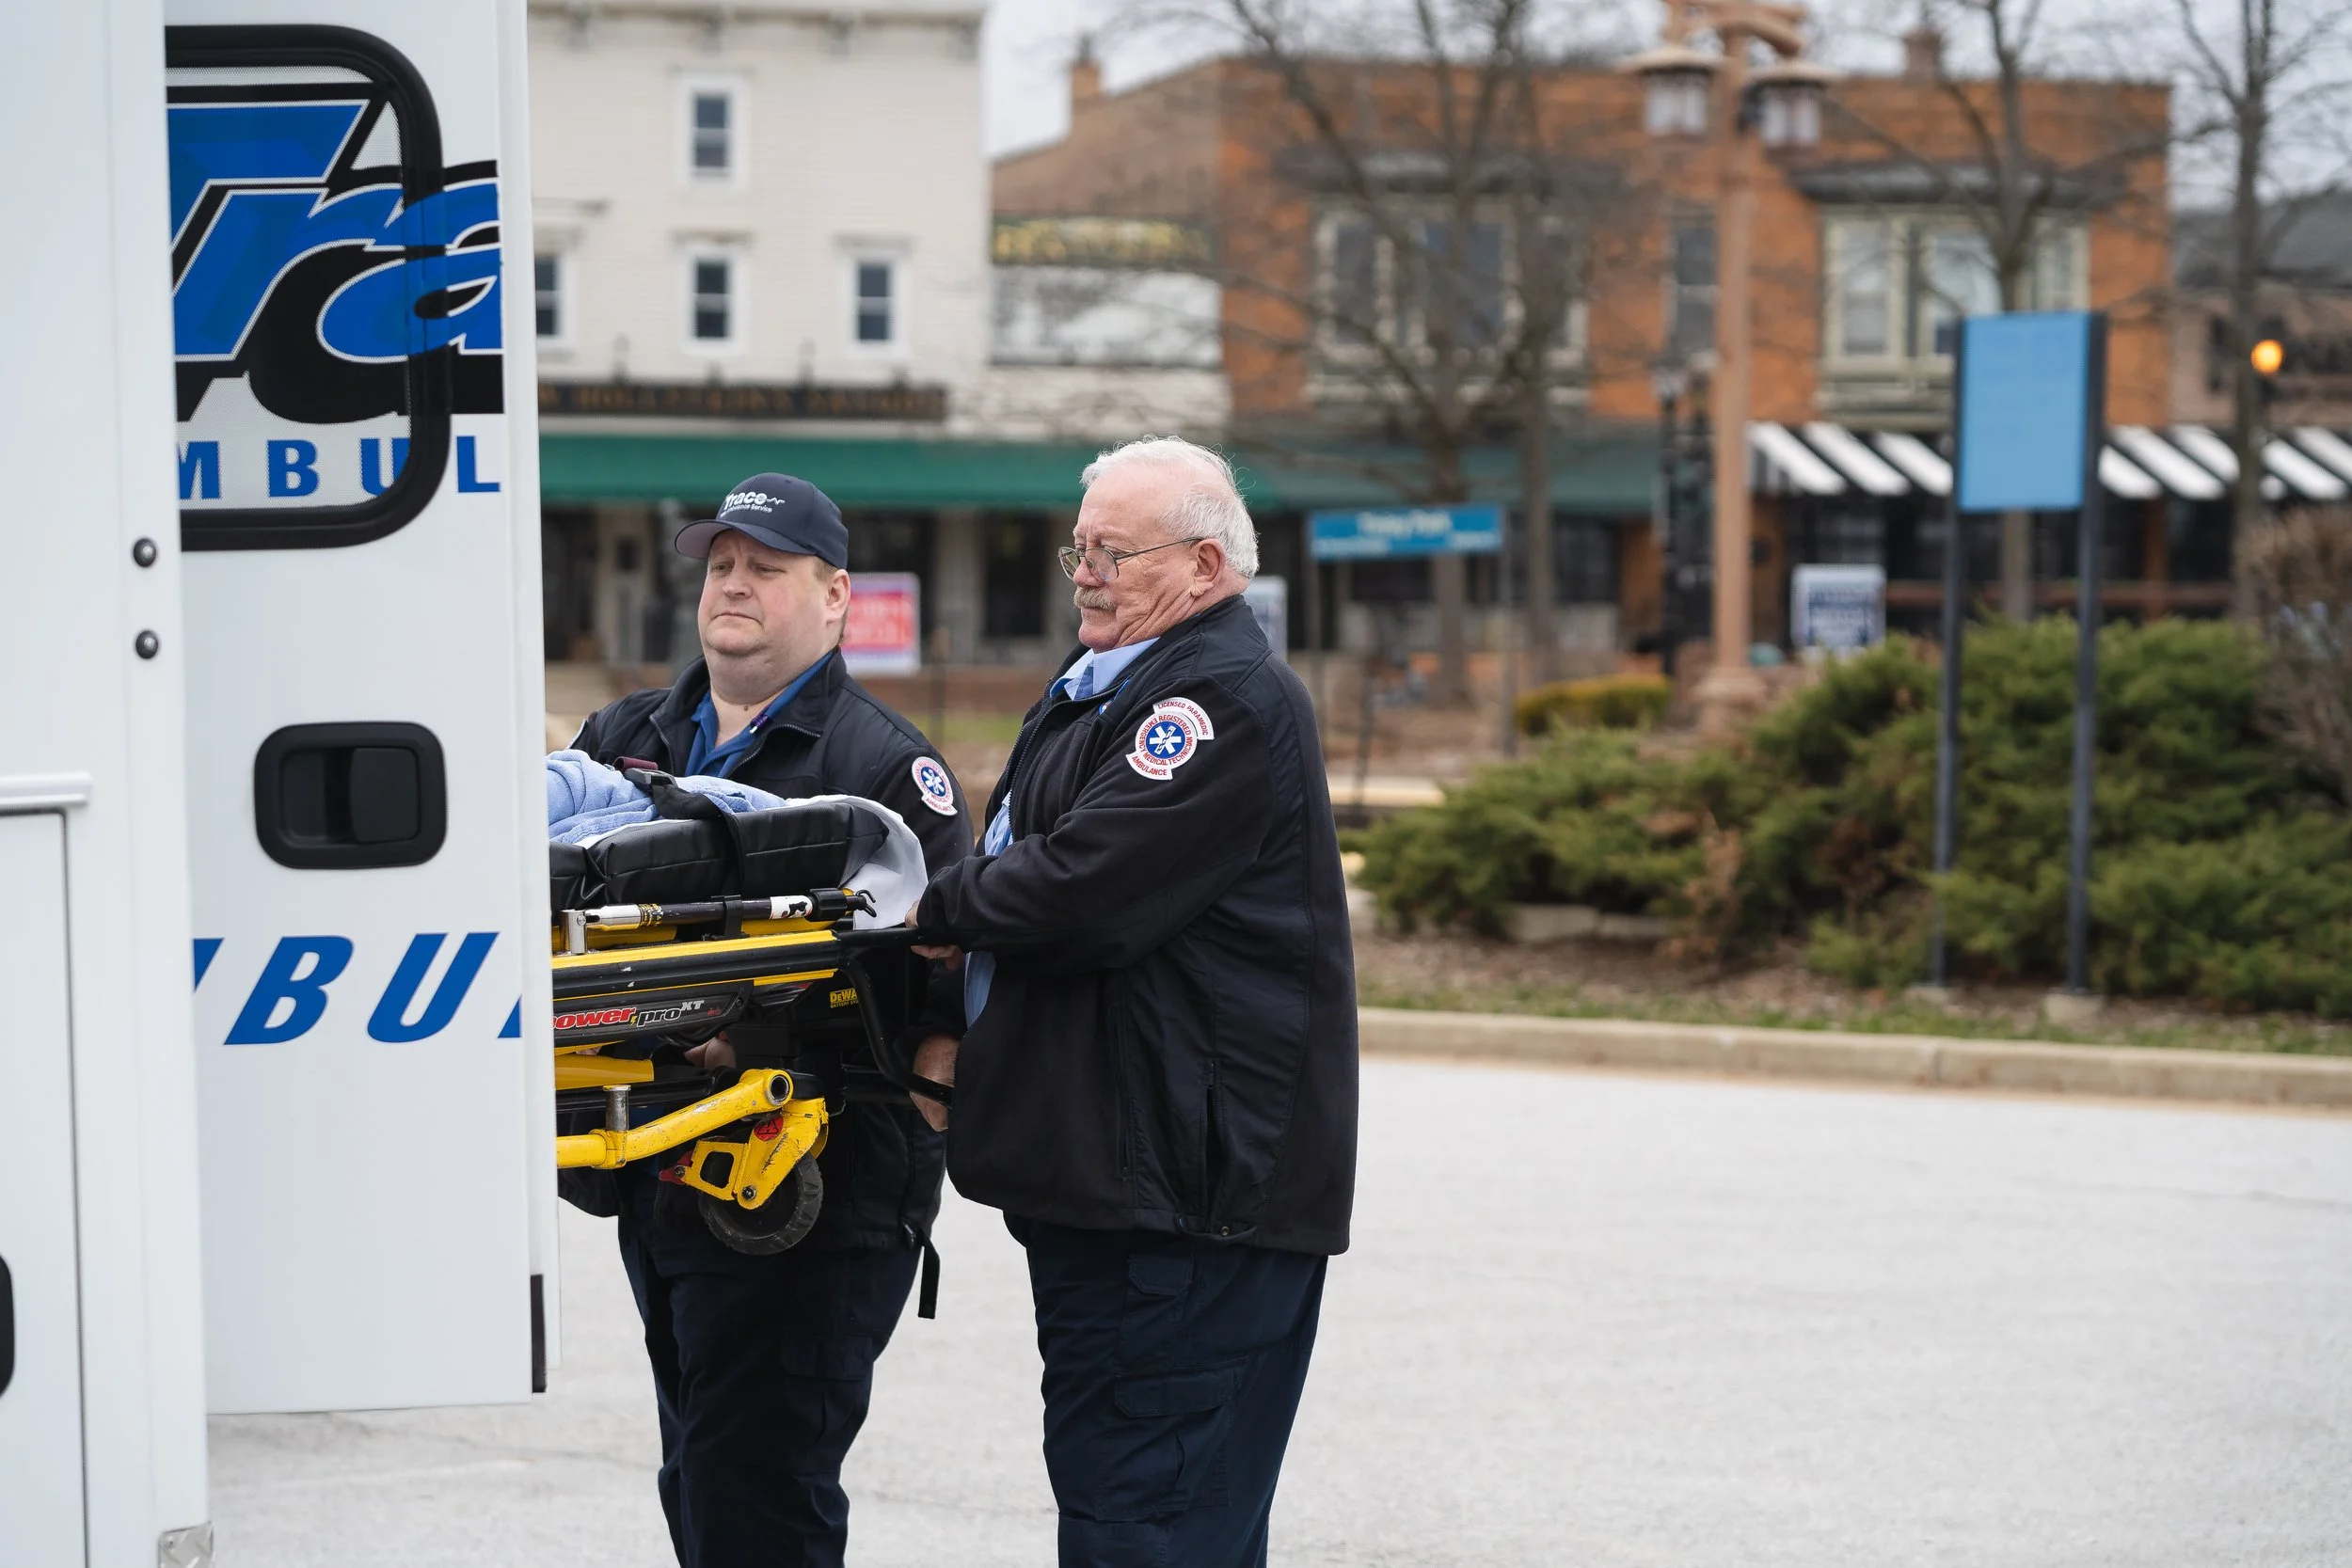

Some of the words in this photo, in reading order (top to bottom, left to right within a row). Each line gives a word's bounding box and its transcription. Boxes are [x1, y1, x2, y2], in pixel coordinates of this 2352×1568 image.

[1157, 701, 1186, 710] LICENSED
[1186, 705, 1209, 736] PARAMEDIC
[1158, 714, 1192, 736] REGISTERED
[1138, 718, 1159, 753] EMERGENCY
[1142, 752, 1168, 767] MEDICAL
[1168, 736, 1194, 766] TECHNICIAN
[1132, 755, 1168, 776] AMBULANCE
